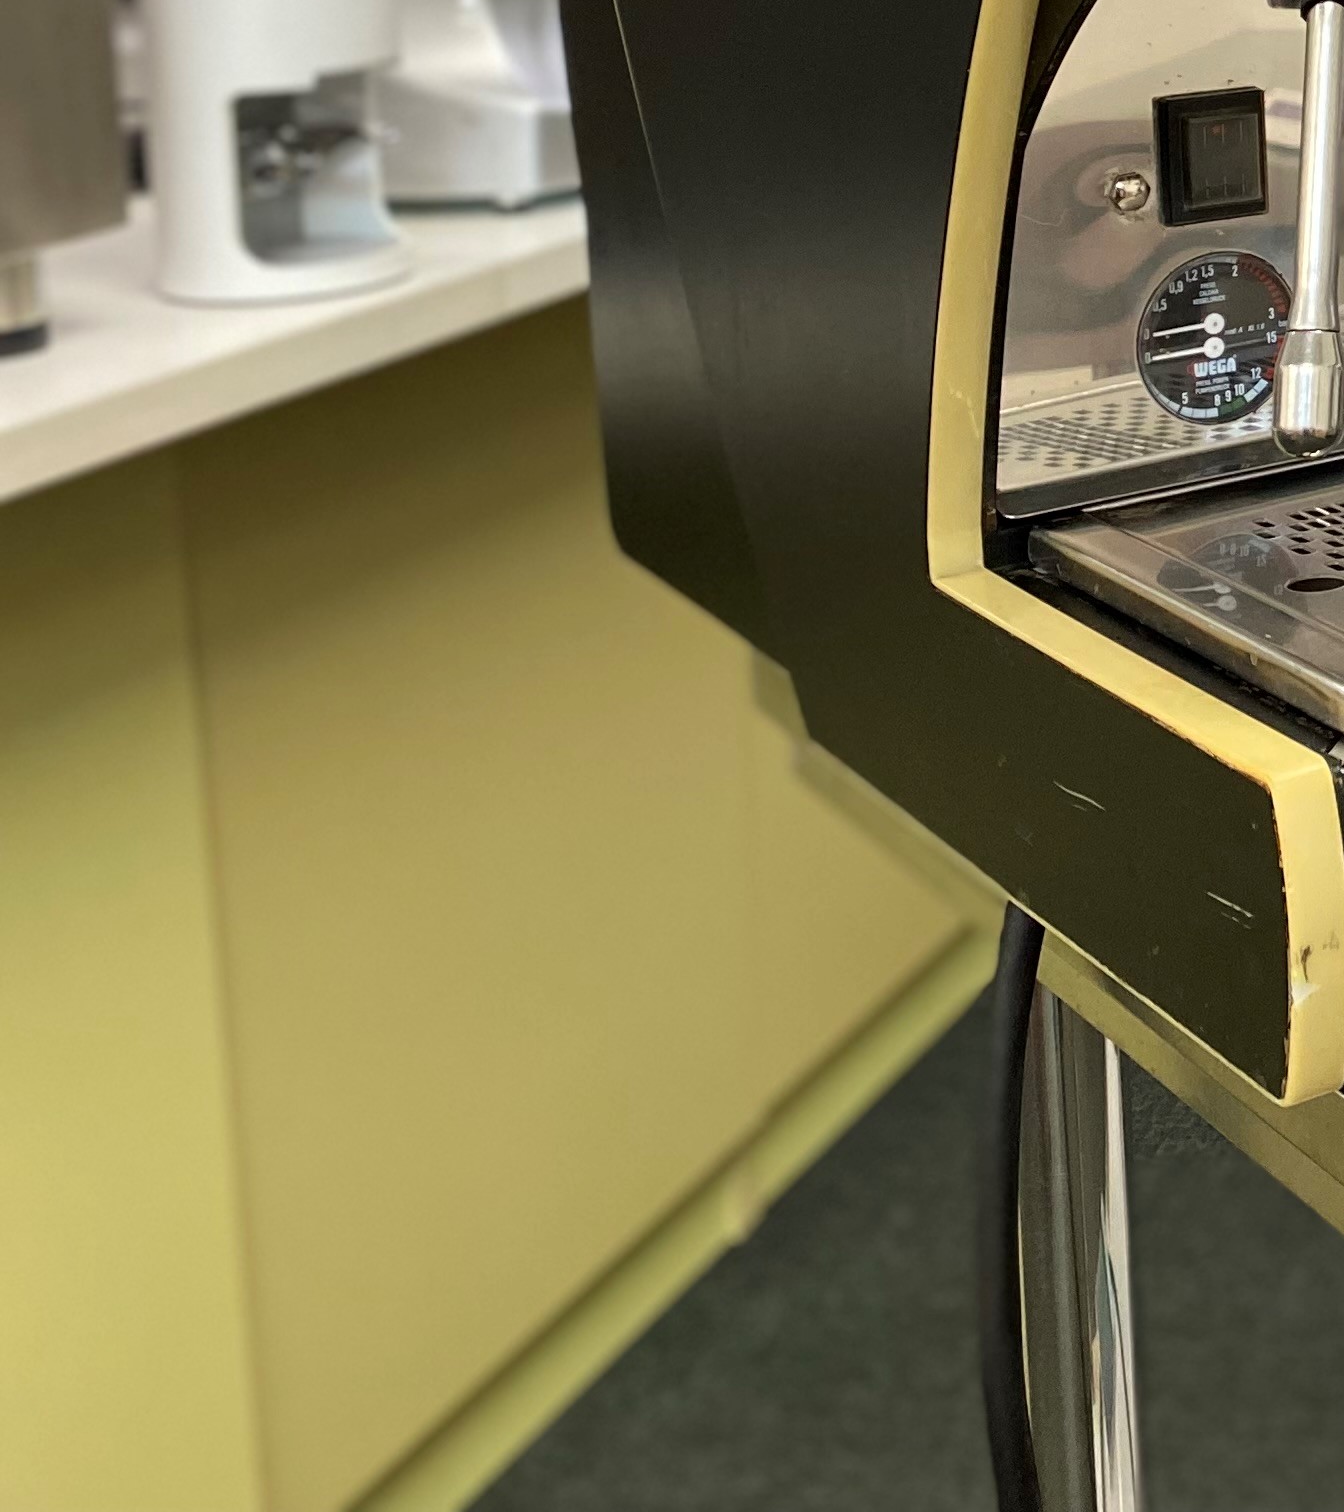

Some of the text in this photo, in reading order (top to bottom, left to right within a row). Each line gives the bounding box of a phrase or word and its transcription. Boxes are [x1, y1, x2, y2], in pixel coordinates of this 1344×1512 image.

[1184, 269, 1199, 283] 1,2
[1231, 265, 1239, 277] 2
[1268, 307, 1275, 320] 3
[1265, 330, 1277, 344] 15
[1194, 357, 1236, 377] WEGA
[1250, 366, 1262, 380] 12
[1234, 383, 1245, 396] 10
[1181, 391, 1189, 405] 5
[1213, 394, 1221, 407] 8
[1224, 390, 1232, 403] 9
